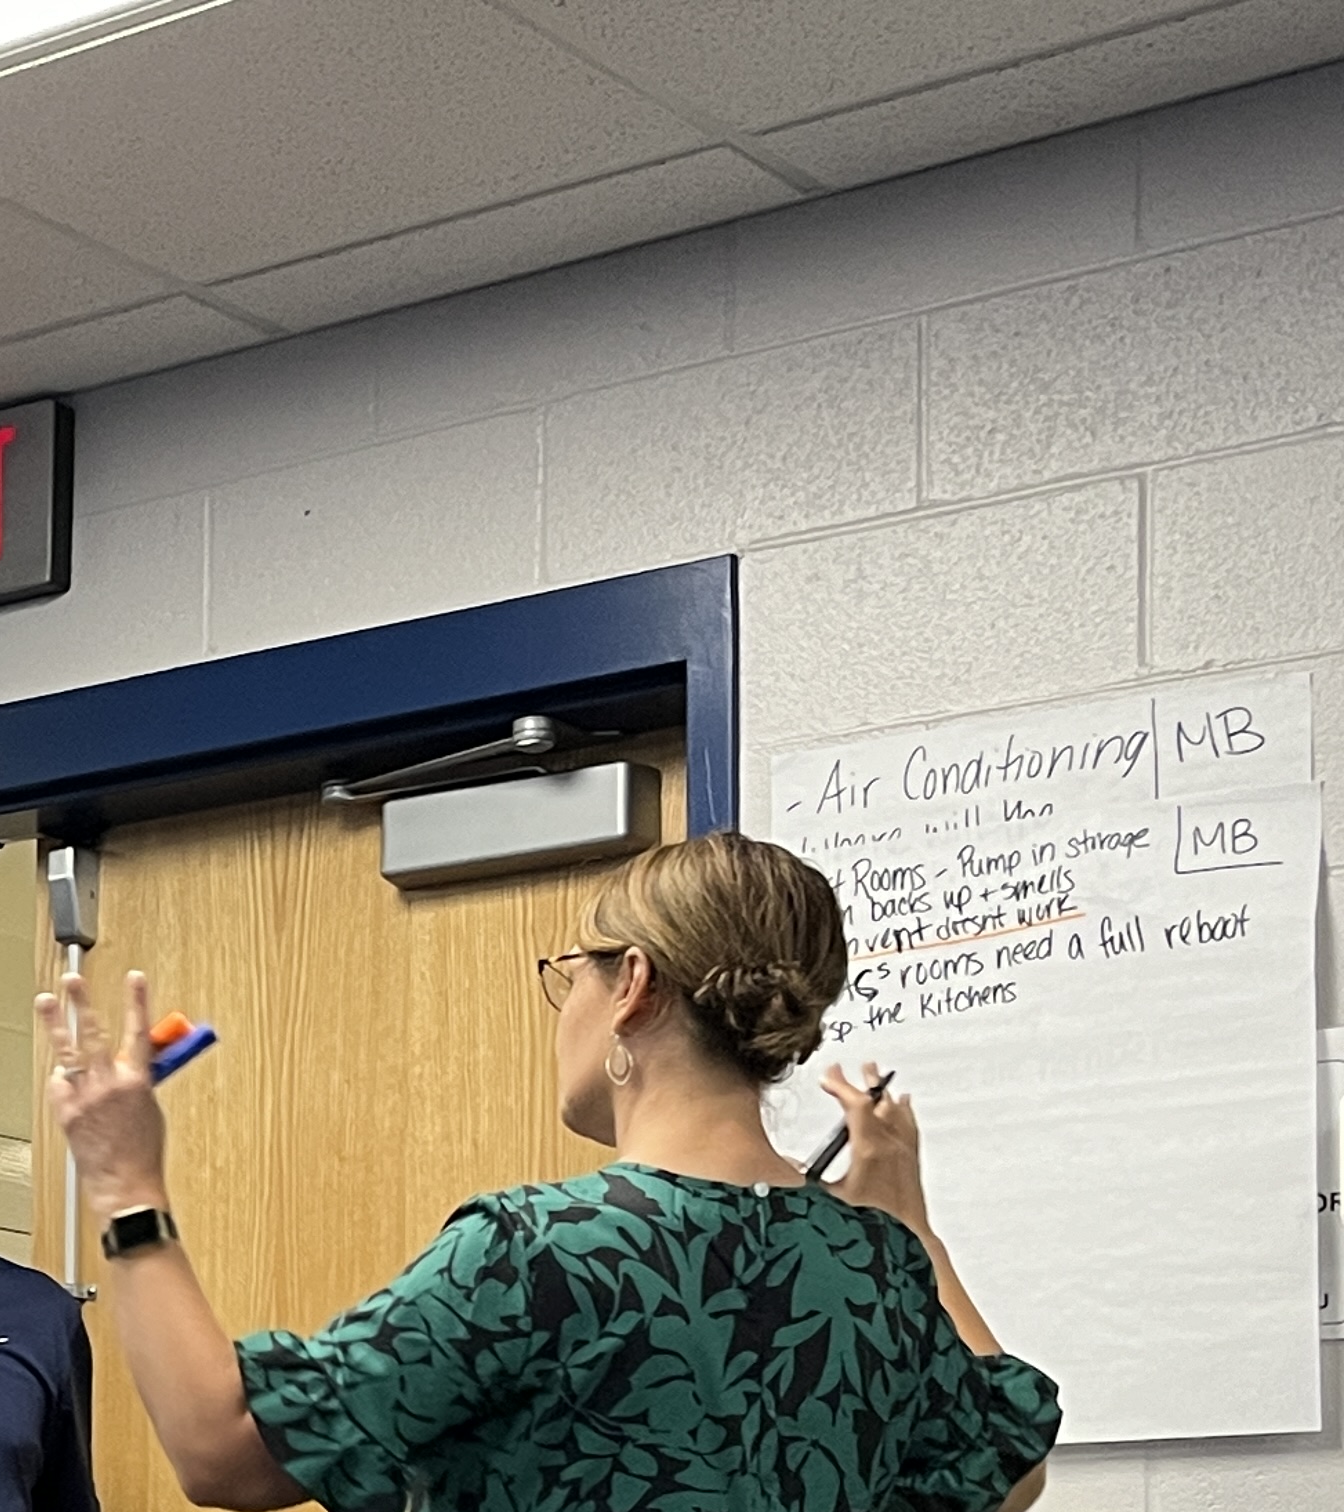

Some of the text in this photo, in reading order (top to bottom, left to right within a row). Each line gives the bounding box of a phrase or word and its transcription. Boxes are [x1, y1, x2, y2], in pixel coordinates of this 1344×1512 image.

[1176, 706, 1265, 762] MB
[815, 758, 881, 814] Air
[903, 729, 1150, 800] Conditioning
[1191, 817, 1259, 856] MB
[851, 858, 927, 897] Rooms
[957, 844, 1022, 879] Pump
[1031, 841, 1056, 866] in
[871, 891, 932, 922] backs
[943, 885, 973, 915] up
[1000, 866, 1075, 902] smells
[865, 916, 933, 954] vent
[1018, 893, 1079, 927] work
[901, 952, 984, 989] rooms
[996, 928, 1053, 969] need
[1068, 932, 1085, 960] a
[1099, 914, 1145, 958] full
[1164, 904, 1251, 949] reboot
[864, 1001, 905, 1031] the
